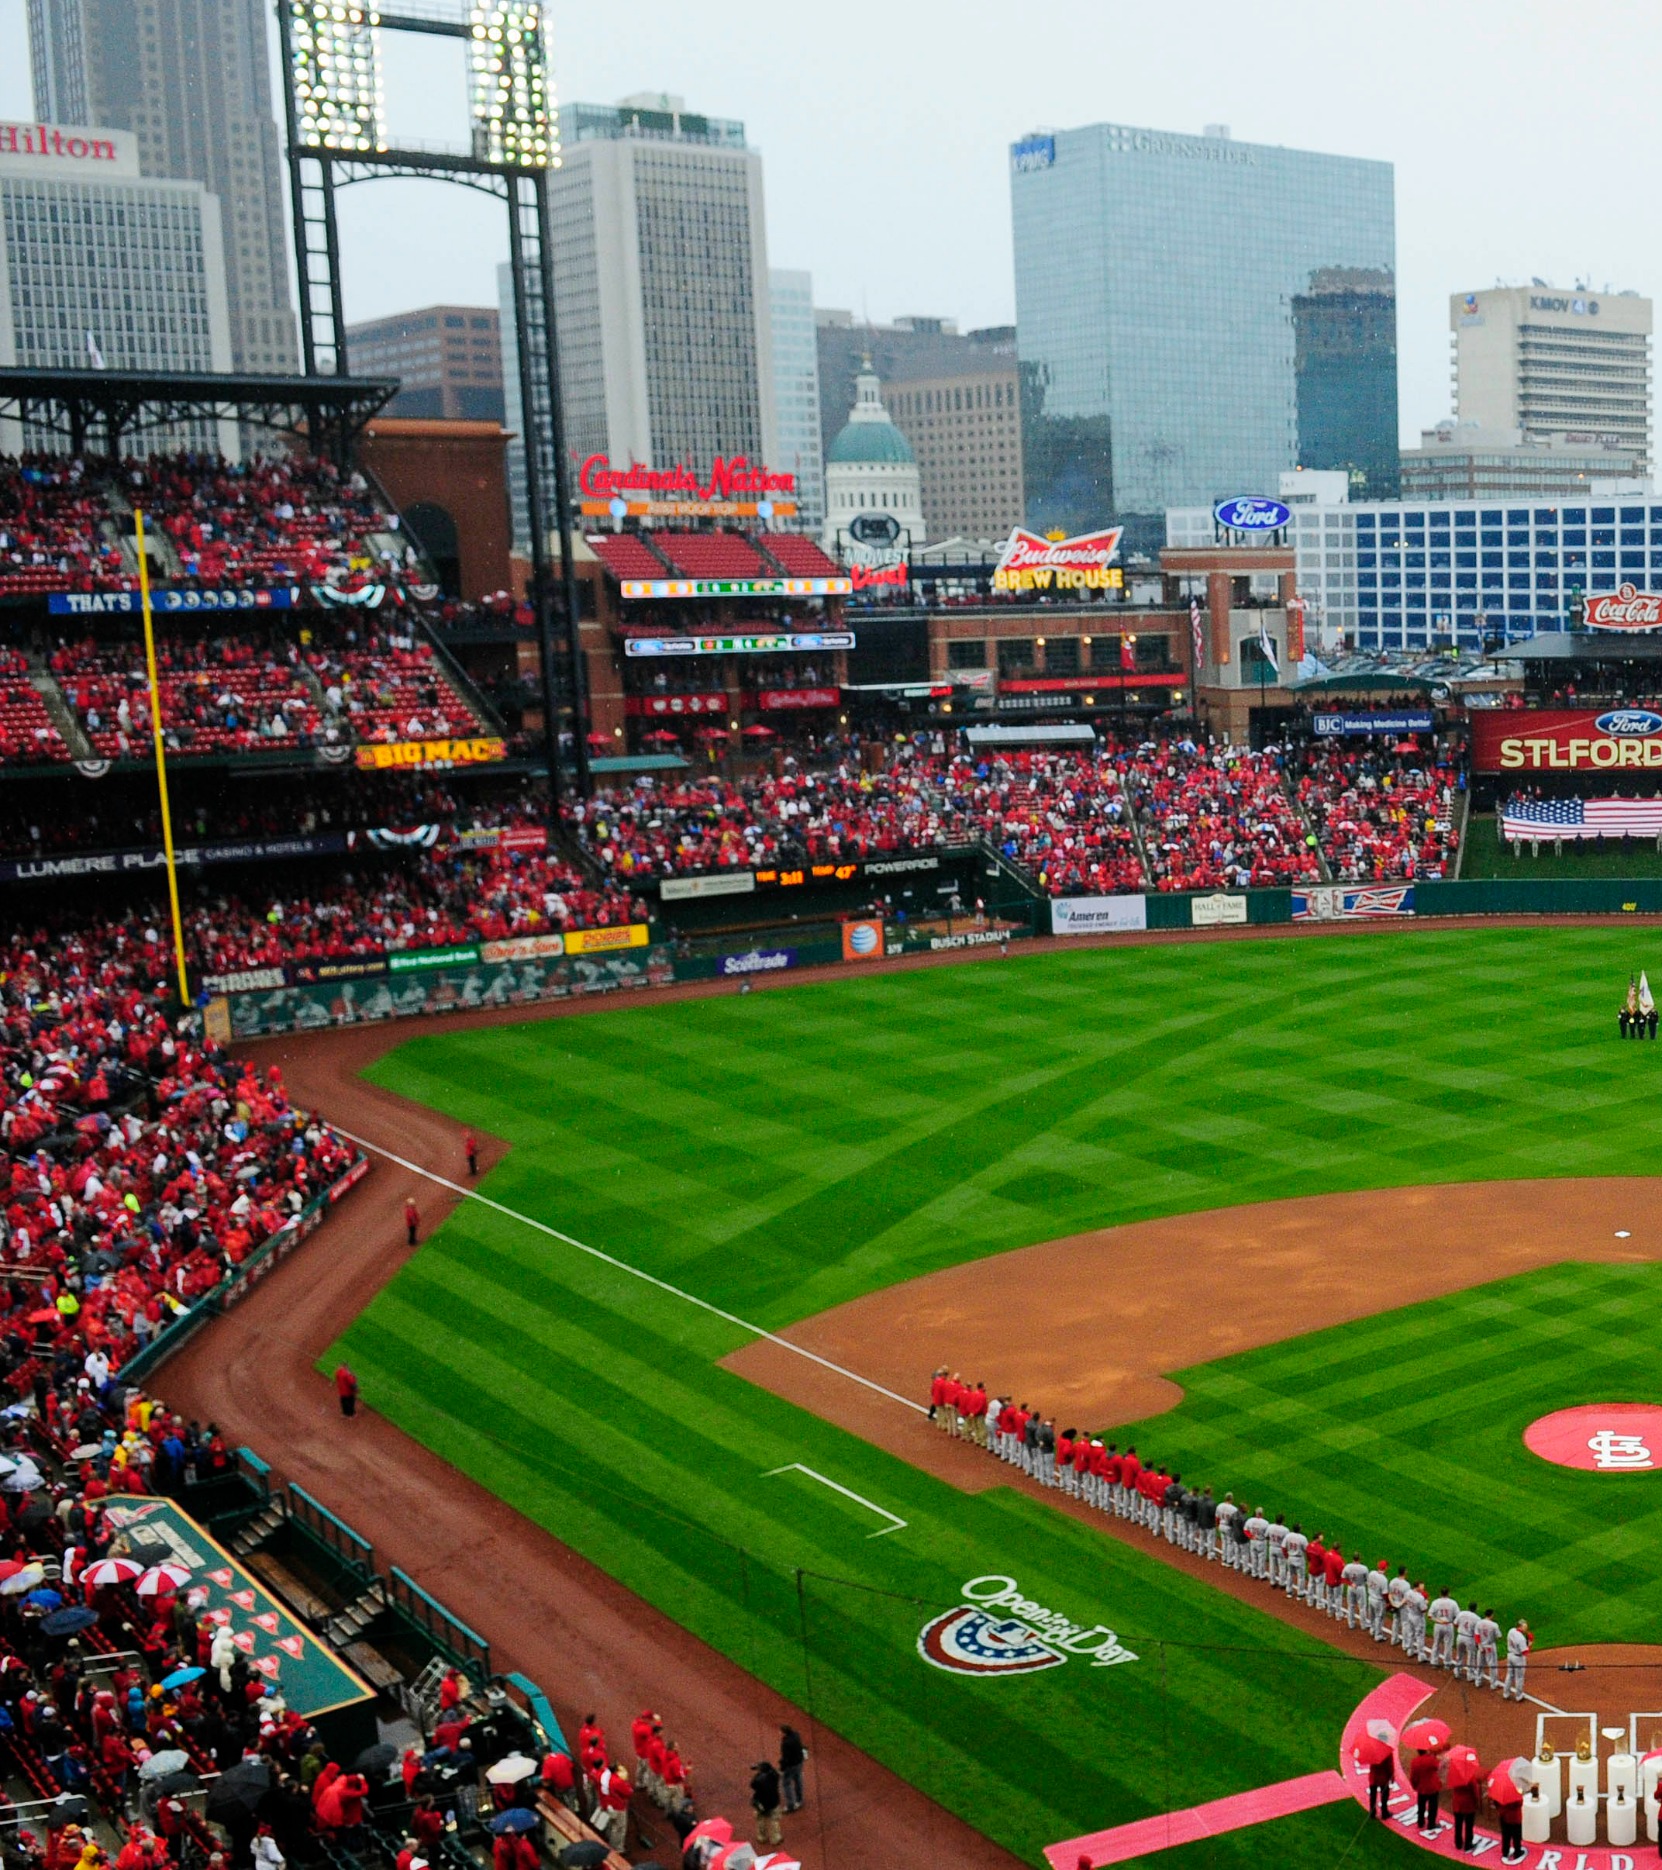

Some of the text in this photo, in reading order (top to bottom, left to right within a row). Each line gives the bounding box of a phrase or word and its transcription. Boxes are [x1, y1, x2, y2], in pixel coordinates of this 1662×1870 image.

[0, 125, 117, 161] Hilton
[1530, 297, 1569, 312] KMOV
[579, 453, 795, 500] Cardinals Nation
[1231, 501, 1279, 526] Ford
[994, 541, 1120, 567] Budweiser
[994, 568, 1123, 590] BREW HOUSE
[66, 593, 132, 612] THAT'S
[1595, 598, 1662, 623] Coca-Cola
[1318, 718, 1341, 732] BJC
[1344, 718, 1431, 731] Making Medicine Better
[1608, 714, 1652, 733] Ford
[372, 741, 423, 768] BIG
[424, 740, 491, 761] MAC
[122, 849, 200, 869] PLACE
[864, 857, 939, 876] POWERADE
[1068, 910, 1109, 922] Ameren
[930, 930, 1011, 950] BUSCH STADIUM
[961, 1574, 1140, 1667] Opening Day
